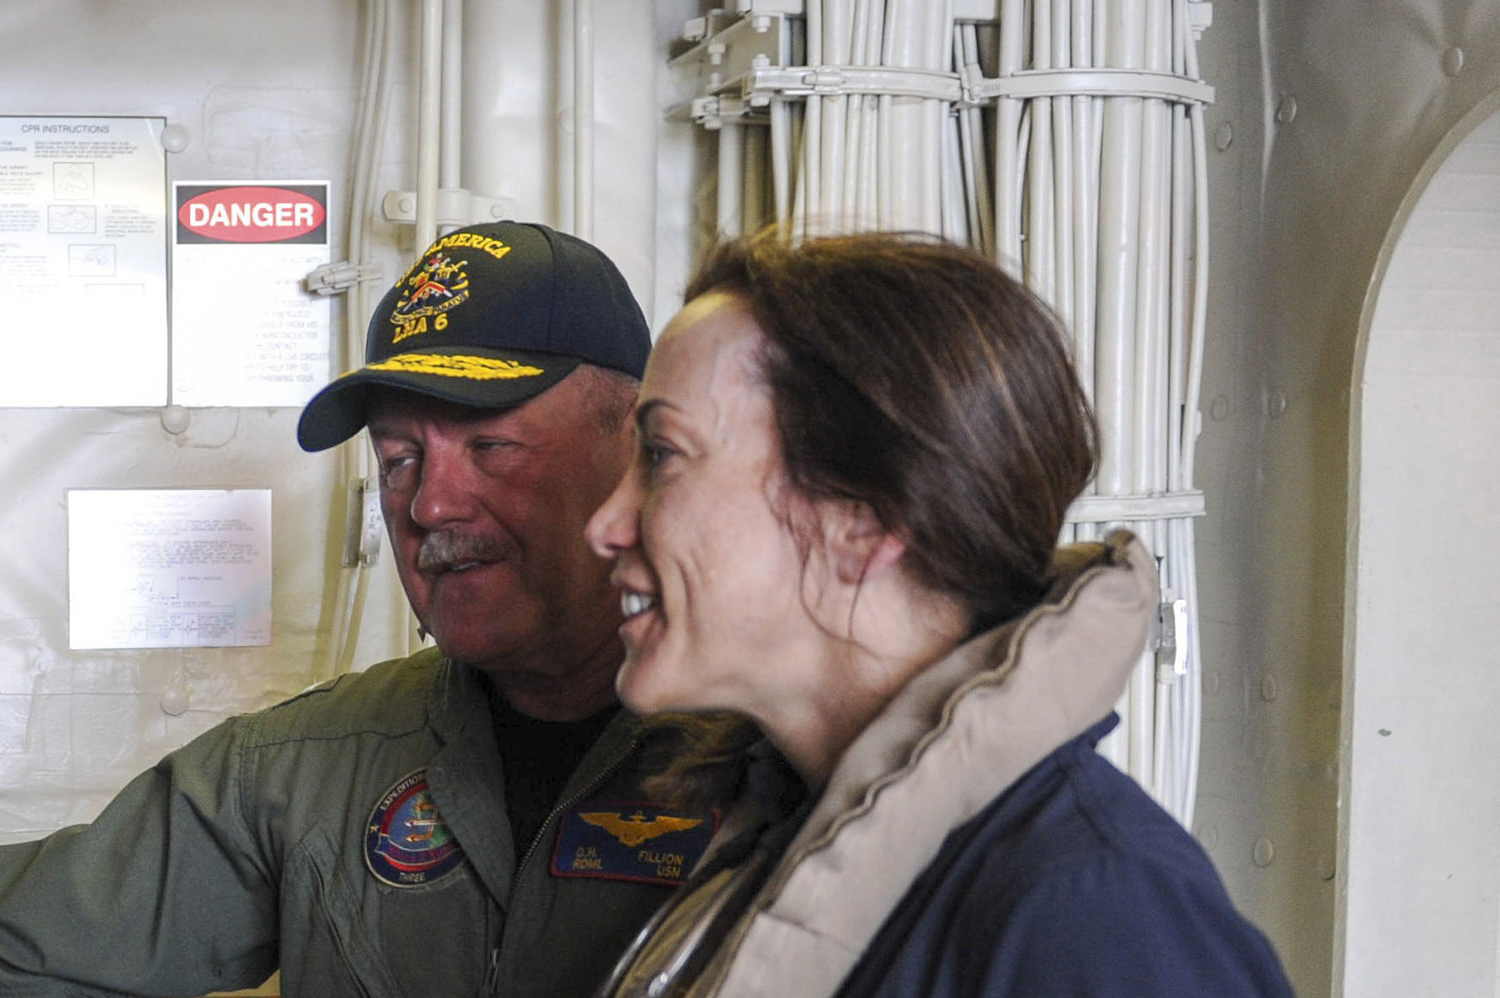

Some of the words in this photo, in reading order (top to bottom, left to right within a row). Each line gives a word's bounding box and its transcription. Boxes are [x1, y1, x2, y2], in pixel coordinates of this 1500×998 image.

[21, 124, 41, 134] CPR
[42, 124, 110, 135] INSTRUCTIONS
[189, 202, 314, 227] DANGER
[392, 316, 428, 344] LHA
[434, 313, 449, 331] 6
[639, 850, 684, 866] FILLION
[657, 865, 681, 879] USN
